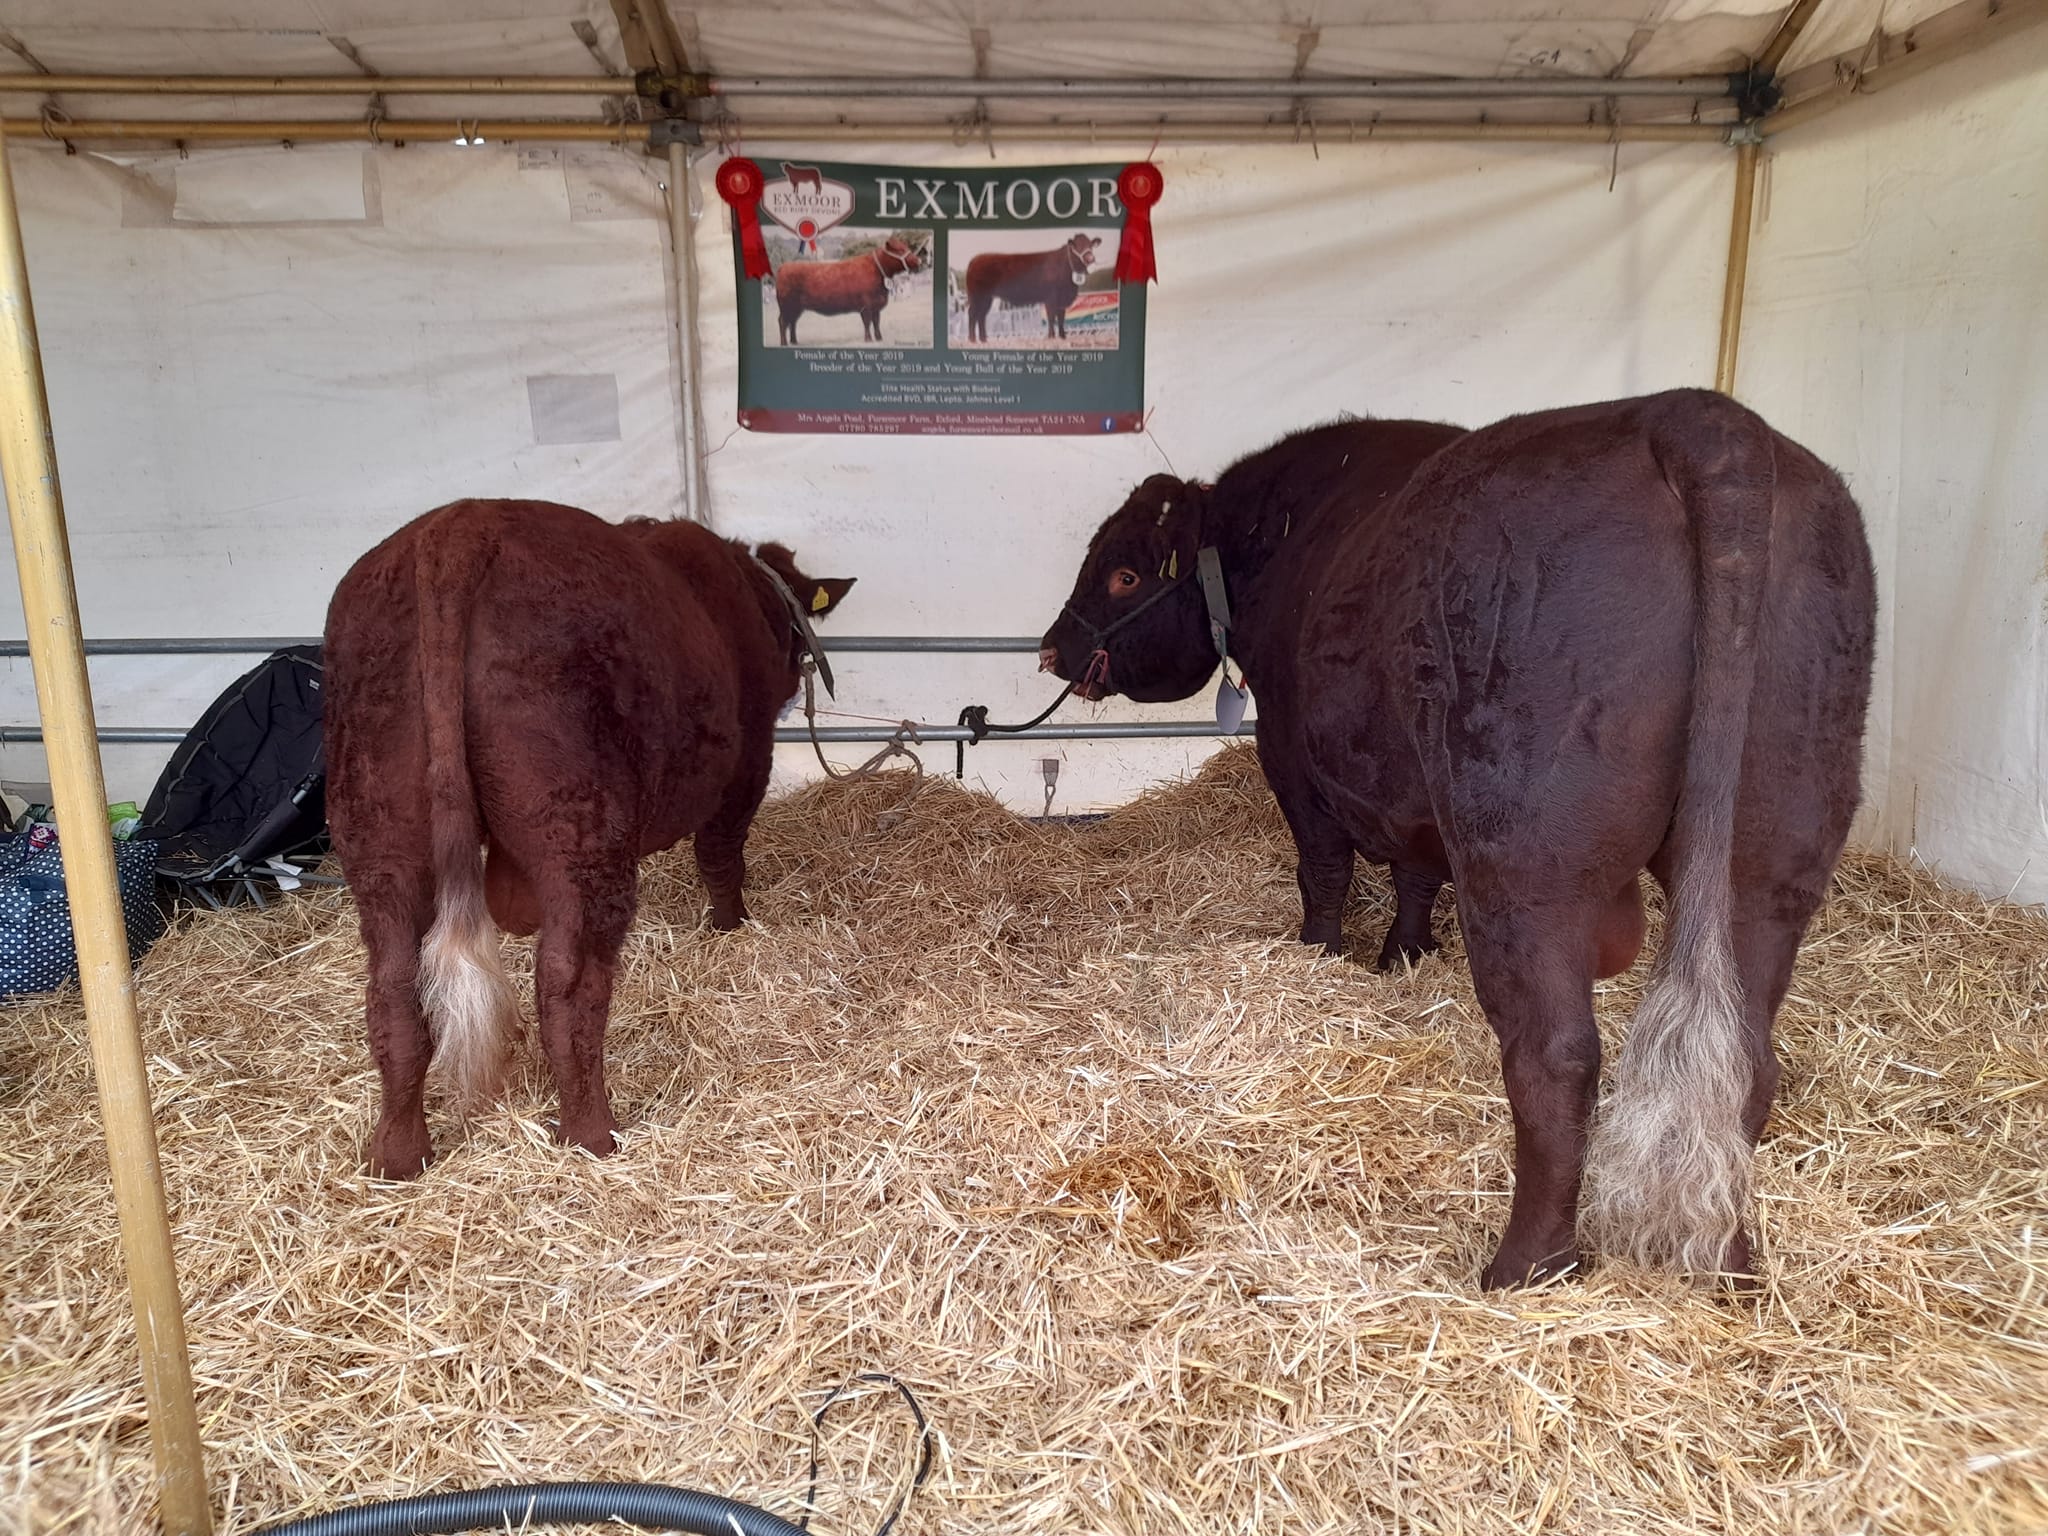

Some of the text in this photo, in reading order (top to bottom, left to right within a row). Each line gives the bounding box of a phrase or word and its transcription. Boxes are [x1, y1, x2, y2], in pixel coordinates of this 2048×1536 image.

[773, 193, 841, 208] EXMOOR
[875, 177, 1122, 220] EXMOOR
[794, 350, 904, 361] Female of the Year 2019
[961, 351, 1104, 363] Young Female of the Year 2019
[810, 362, 1073, 375] Breeder of the Year 2019 and Young Bull of the Year 2019
[900, 384, 926, 393] Health
[927, 384, 951, 393] Status
[952, 384, 970, 393] with
[861, 394, 903, 403] Accredited
[797, 413, 814, 423] Mrs
[815, 413, 842, 425] Angela
[1005, 414, 1039, 425] Somerset
